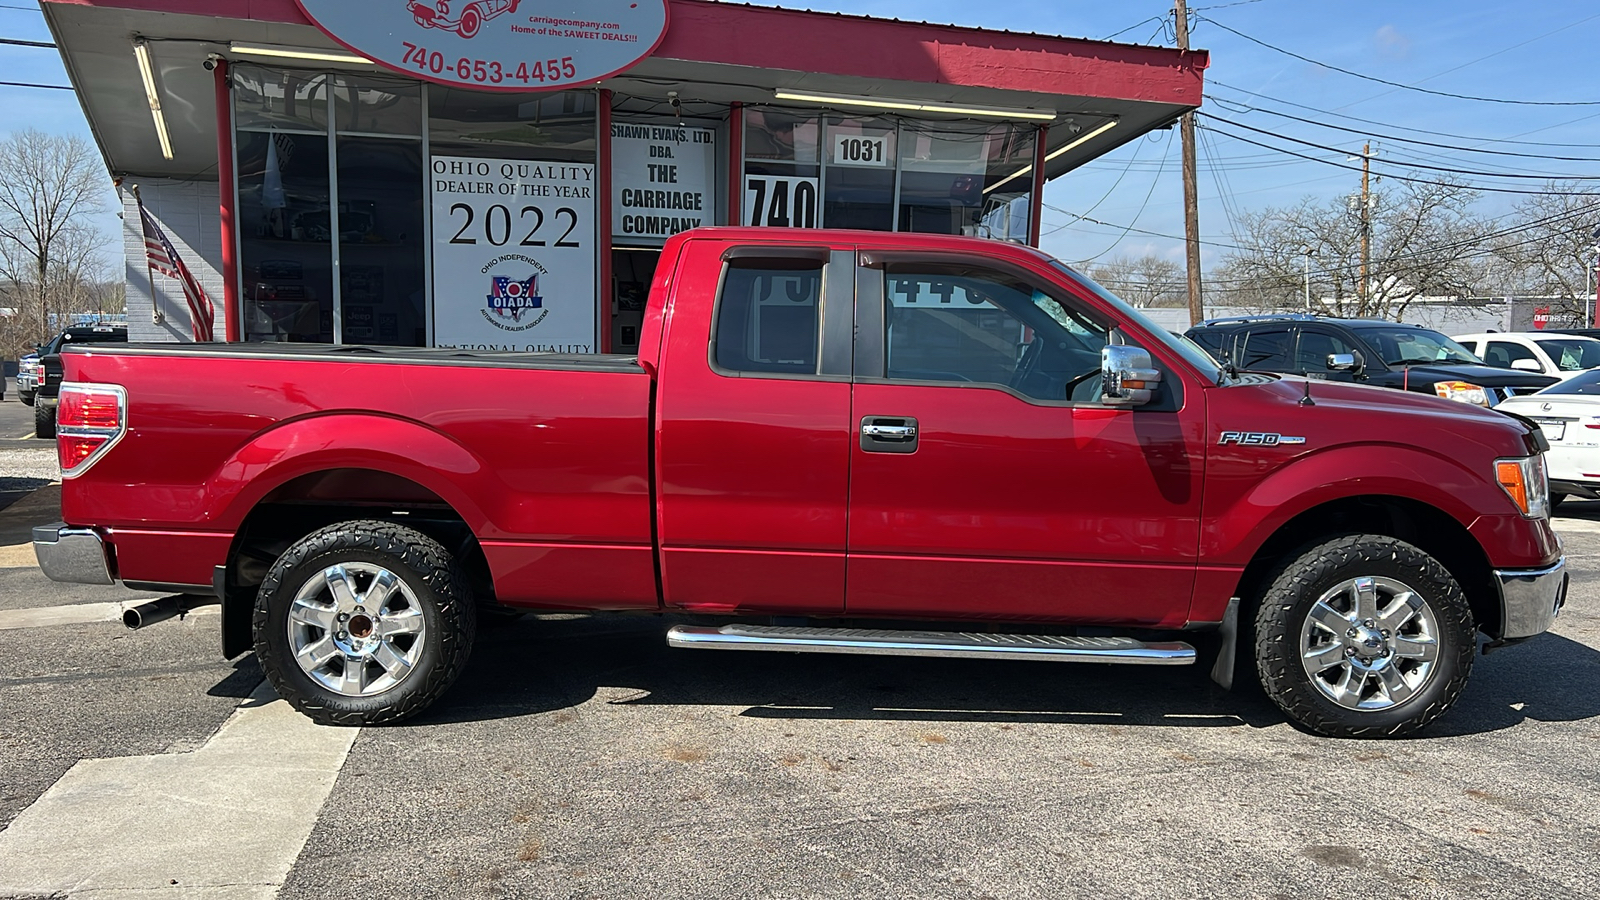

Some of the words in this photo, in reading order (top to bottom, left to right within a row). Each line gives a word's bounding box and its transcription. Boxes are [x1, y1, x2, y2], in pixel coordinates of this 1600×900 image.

[529, 15, 620, 30] carriagecompany.com
[511, 25, 536, 35] Home
[537, 27, 547, 35] of
[548, 28, 563, 37] the
[564, 29, 600, 40] SAWEET
[601, 32, 638, 43] DEALS!!!
[401, 41, 577, 84] 740-653-4455
[611, 124, 649, 140] SHAWN
[693, 130, 714, 144] LTD.
[649, 145, 675, 159] DBA.
[840, 138, 883, 162] 1031
[433, 160, 490, 176] OHIO
[500, 163, 594, 181] QUALITY
[647, 164, 678, 184] THE
[436, 180, 495, 195] DEALER
[498, 182, 518, 196] OF
[520, 184, 550, 197] THE
[553, 185, 591, 199] YEAR
[622, 188, 702, 211] CARRIAGE
[748, 179, 816, 228] 740
[449, 202, 580, 248] 2022
[481, 258, 498, 274] OHIO
[498, 254, 549, 275] INDEPENDENT
[493, 297, 534, 308] OIADA
[480, 308, 505, 330] AUTOMOBILE
[525, 308, 549, 330] ASSOCIATION
